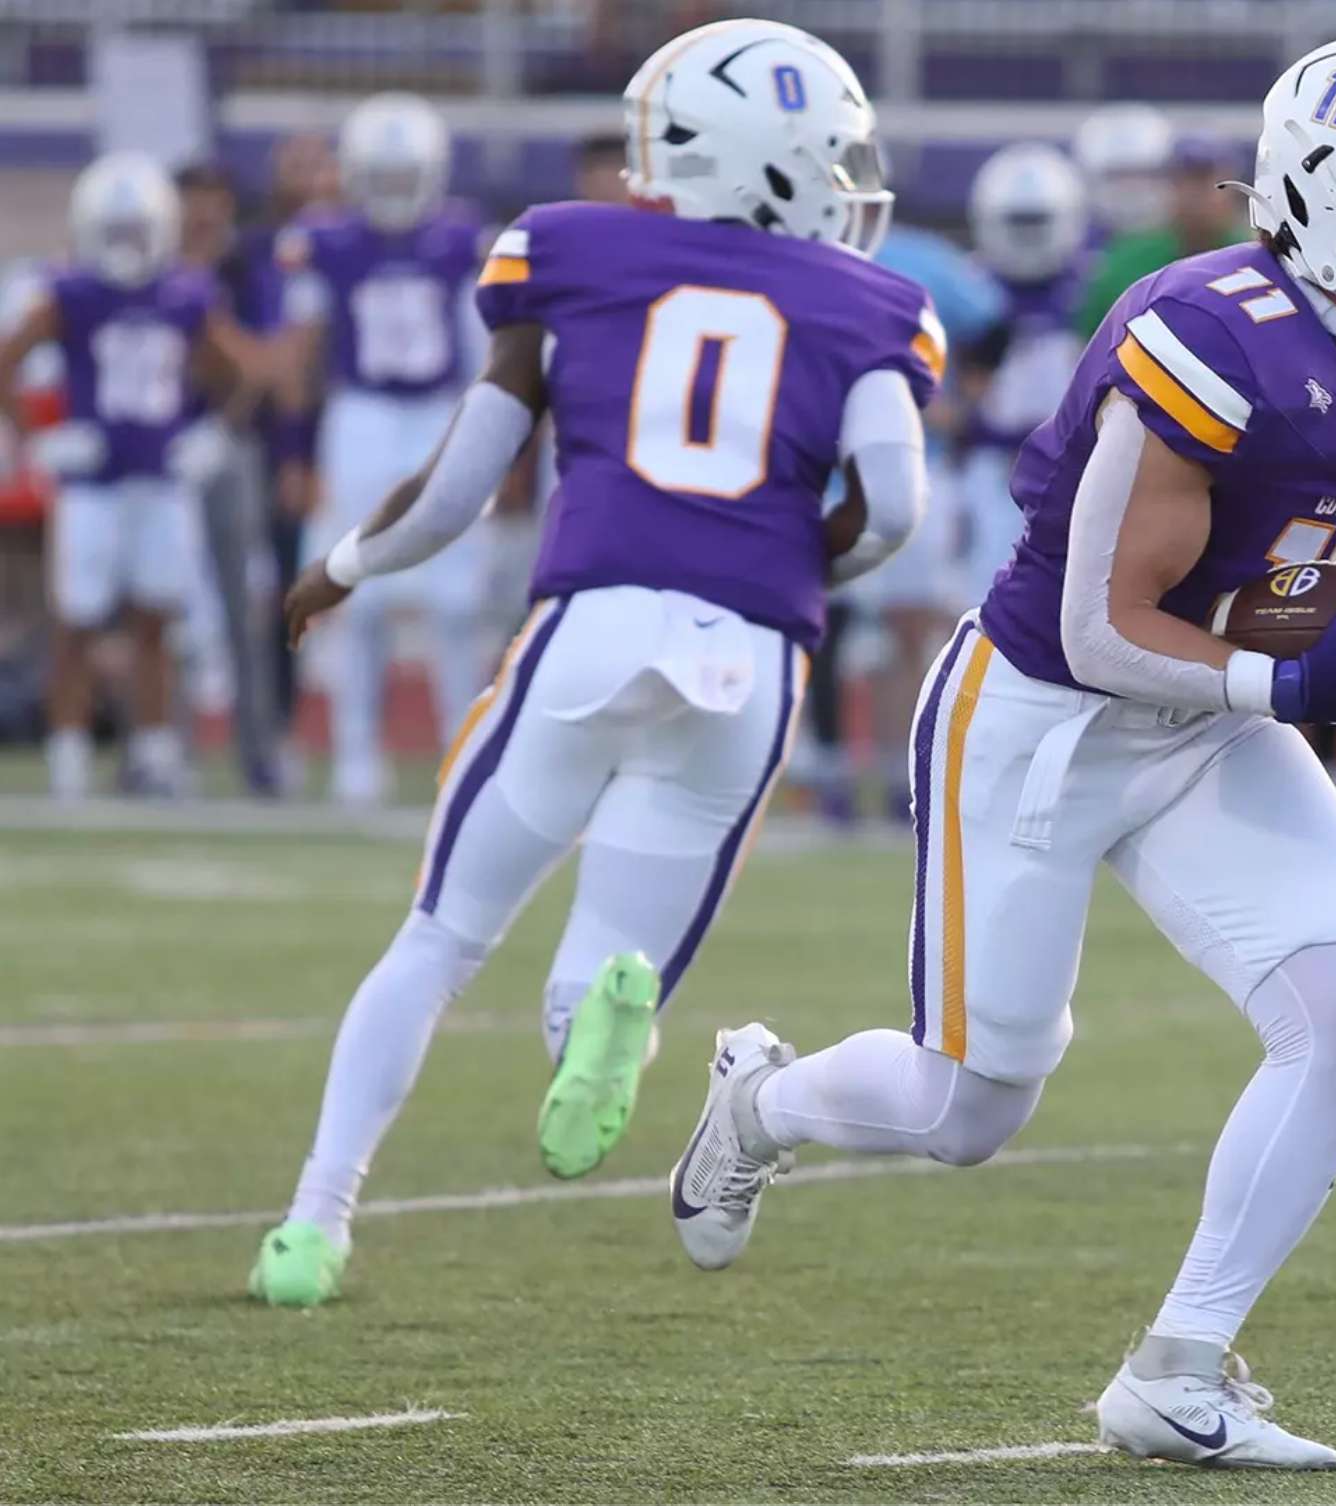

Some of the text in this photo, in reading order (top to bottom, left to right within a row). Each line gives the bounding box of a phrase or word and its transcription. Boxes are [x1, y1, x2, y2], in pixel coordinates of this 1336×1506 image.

[771, 64, 808, 112] 0
[1205, 266, 1298, 324] 11
[625, 283, 789, 499] 0
[716, 1047, 735, 1078] 11
